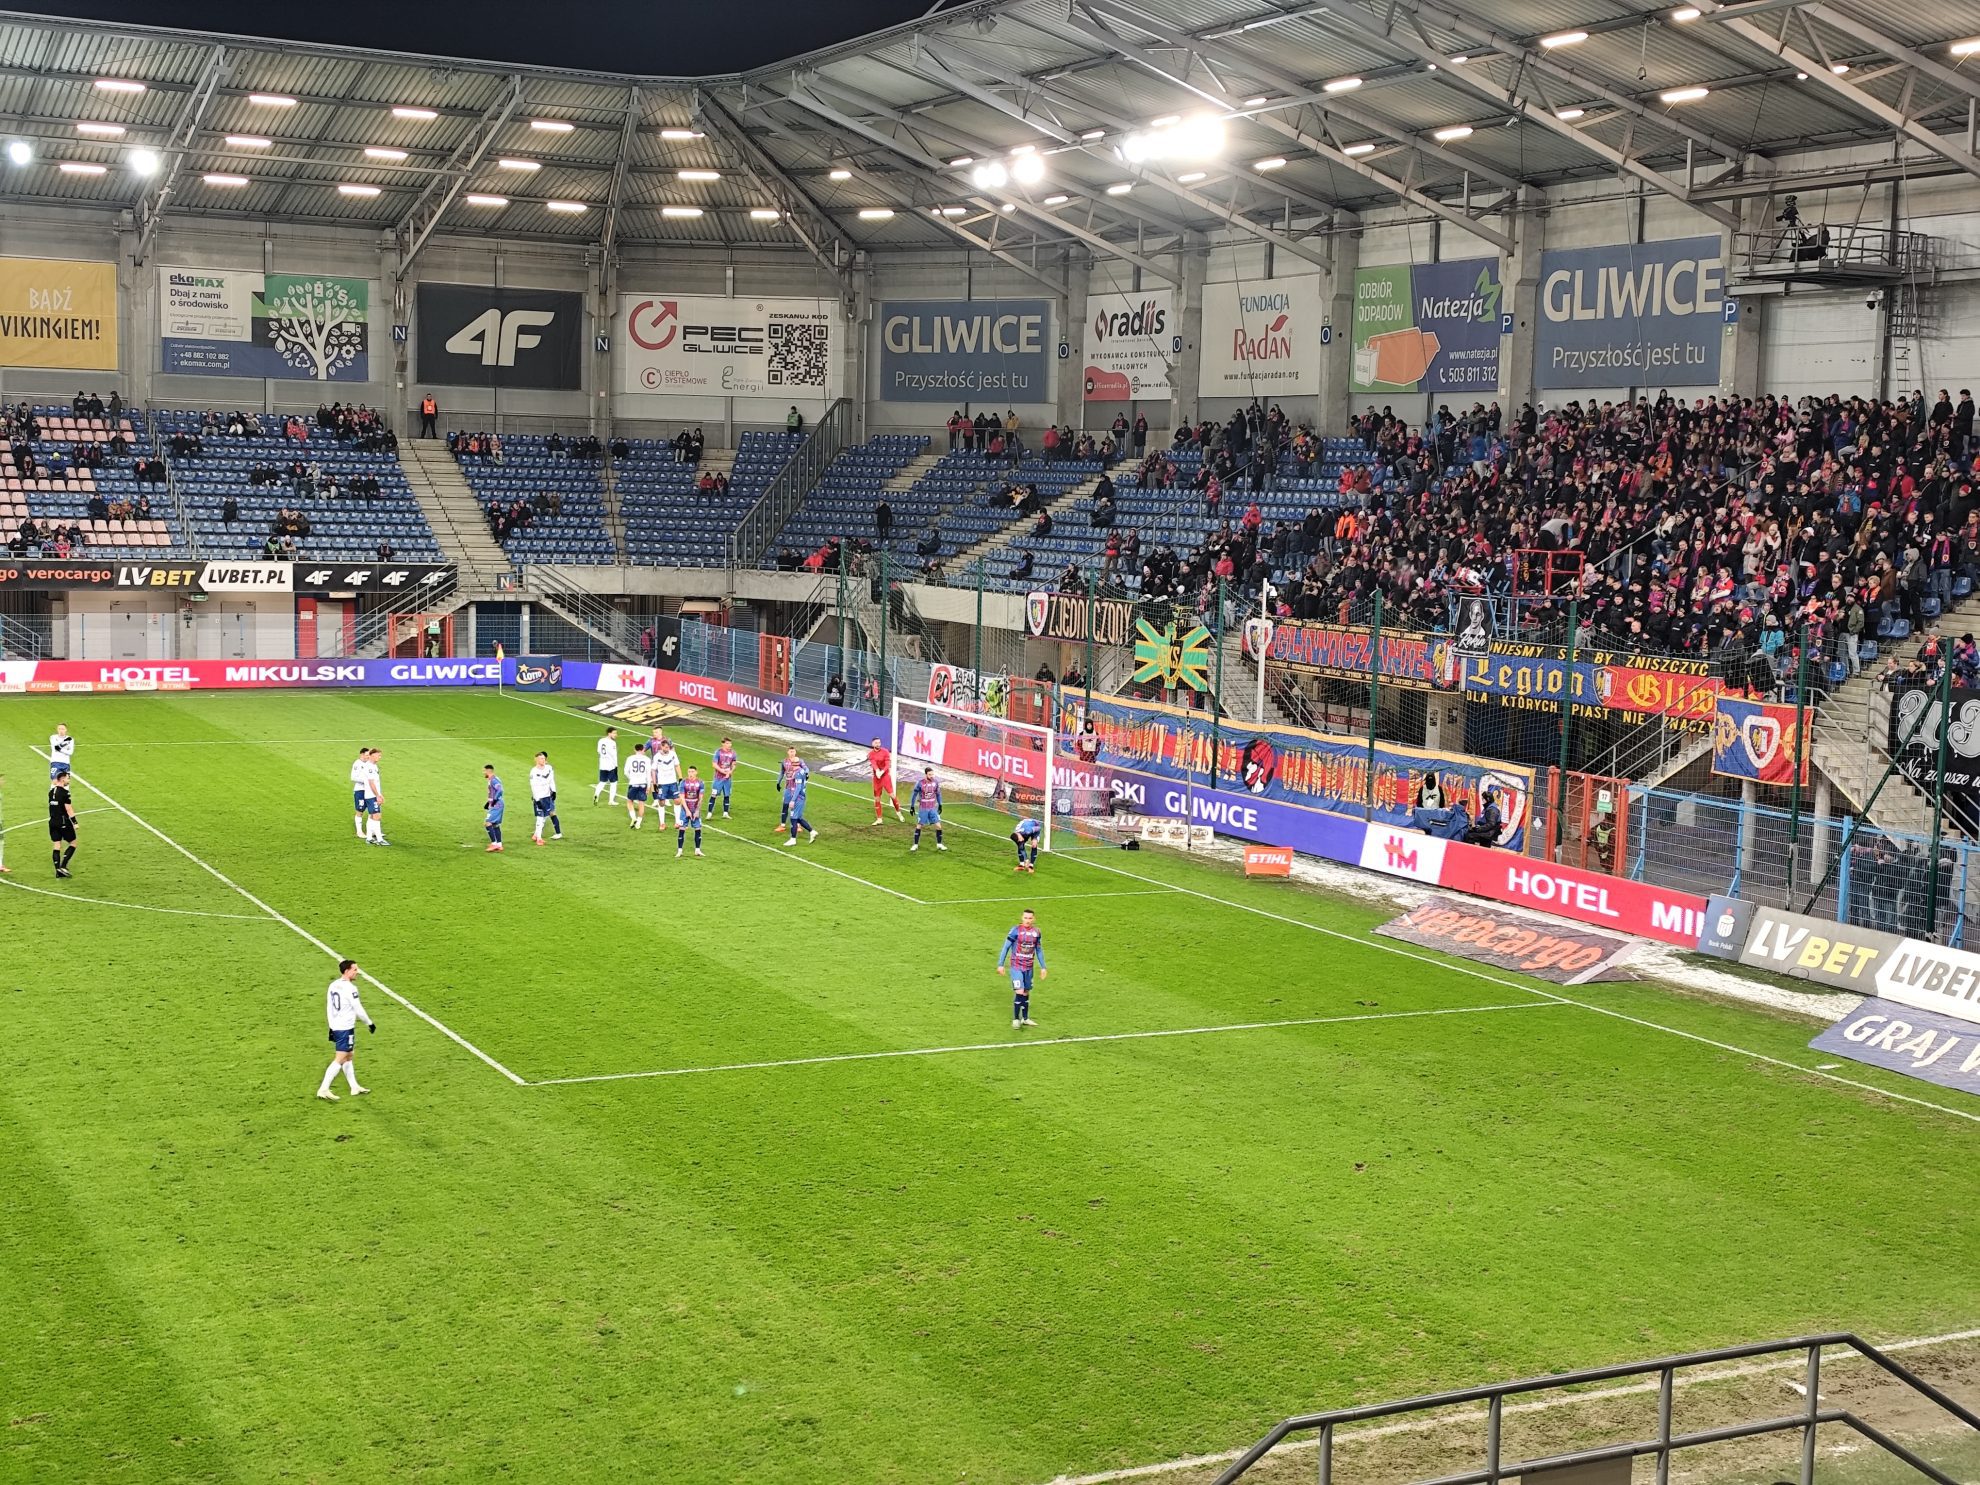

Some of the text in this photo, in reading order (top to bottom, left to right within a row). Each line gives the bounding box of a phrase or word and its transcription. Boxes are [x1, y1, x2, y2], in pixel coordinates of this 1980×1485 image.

[199, 291, 221, 299] nami
[1359, 277, 1393, 299] ODBIÓR
[1543, 257, 1723, 322] GLIWICE
[29, 286, 73, 314] BĄDŹ
[178, 298, 229, 310] środowisko
[1241, 293, 1290, 313] FUNDACJA
[1421, 292, 1484, 323] Natezja
[1358, 303, 1403, 322] ODPADÓW
[1724, 302, 1736, 322] P
[0, 315, 100, 340] VIKINGIEM!
[1502, 315, 1512, 332] P
[394, 327, 407, 341] N
[445, 308, 555, 367] 4F
[683, 326, 764, 343] PEC
[884, 315, 1042, 354] GLIWICE
[597, 338, 609, 351] N
[683, 344, 764, 355] GLIWICE
[1449, 348, 1498, 361] www.natezja.pl
[1553, 342, 1705, 373] Przyszłość jest tu
[665, 377, 707, 385] SYSTEMOWE
[895, 371, 1028, 391] Przyszłość jest tu
[1224, 371, 1299, 381] www.fundacjaradan.org
[1449, 366, 1497, 382] 503 811 312
[27, 568, 111, 582] verocargo
[208, 570, 286, 583] LVBET.PL
[304, 570, 333, 585] 4F
[343, 570, 372, 585] 4F
[382, 571, 409, 585] 4F
[1049, 596, 1133, 645] ZJEDNCZONY
[1594, 652, 1614, 665] BY
[100, 667, 200, 683] HOTEL
[226, 667, 365, 681] MIKULSKI
[390, 664, 500, 680] GLIWICE
[679, 680, 848, 733] HOTEL MIKULSKI GLIWICE
[1466, 690, 1488, 703] DLA
[1501, 694, 1558, 713] KTÓRYCH
[1571, 703, 1609, 720] PIAST
[1623, 711, 1646, 725] NIE
[601, 743, 607, 756] 6
[632, 760, 646, 774] 96
[977, 748, 1034, 779] HOTEL
[1165, 791, 1258, 831] GLIWICE
[1248, 853, 1290, 864] STIHL
[1507, 867, 1620, 917] HOTEL
[1402, 906, 1603, 971] verocargo
[1843, 1015, 1962, 1068] GRAJ
